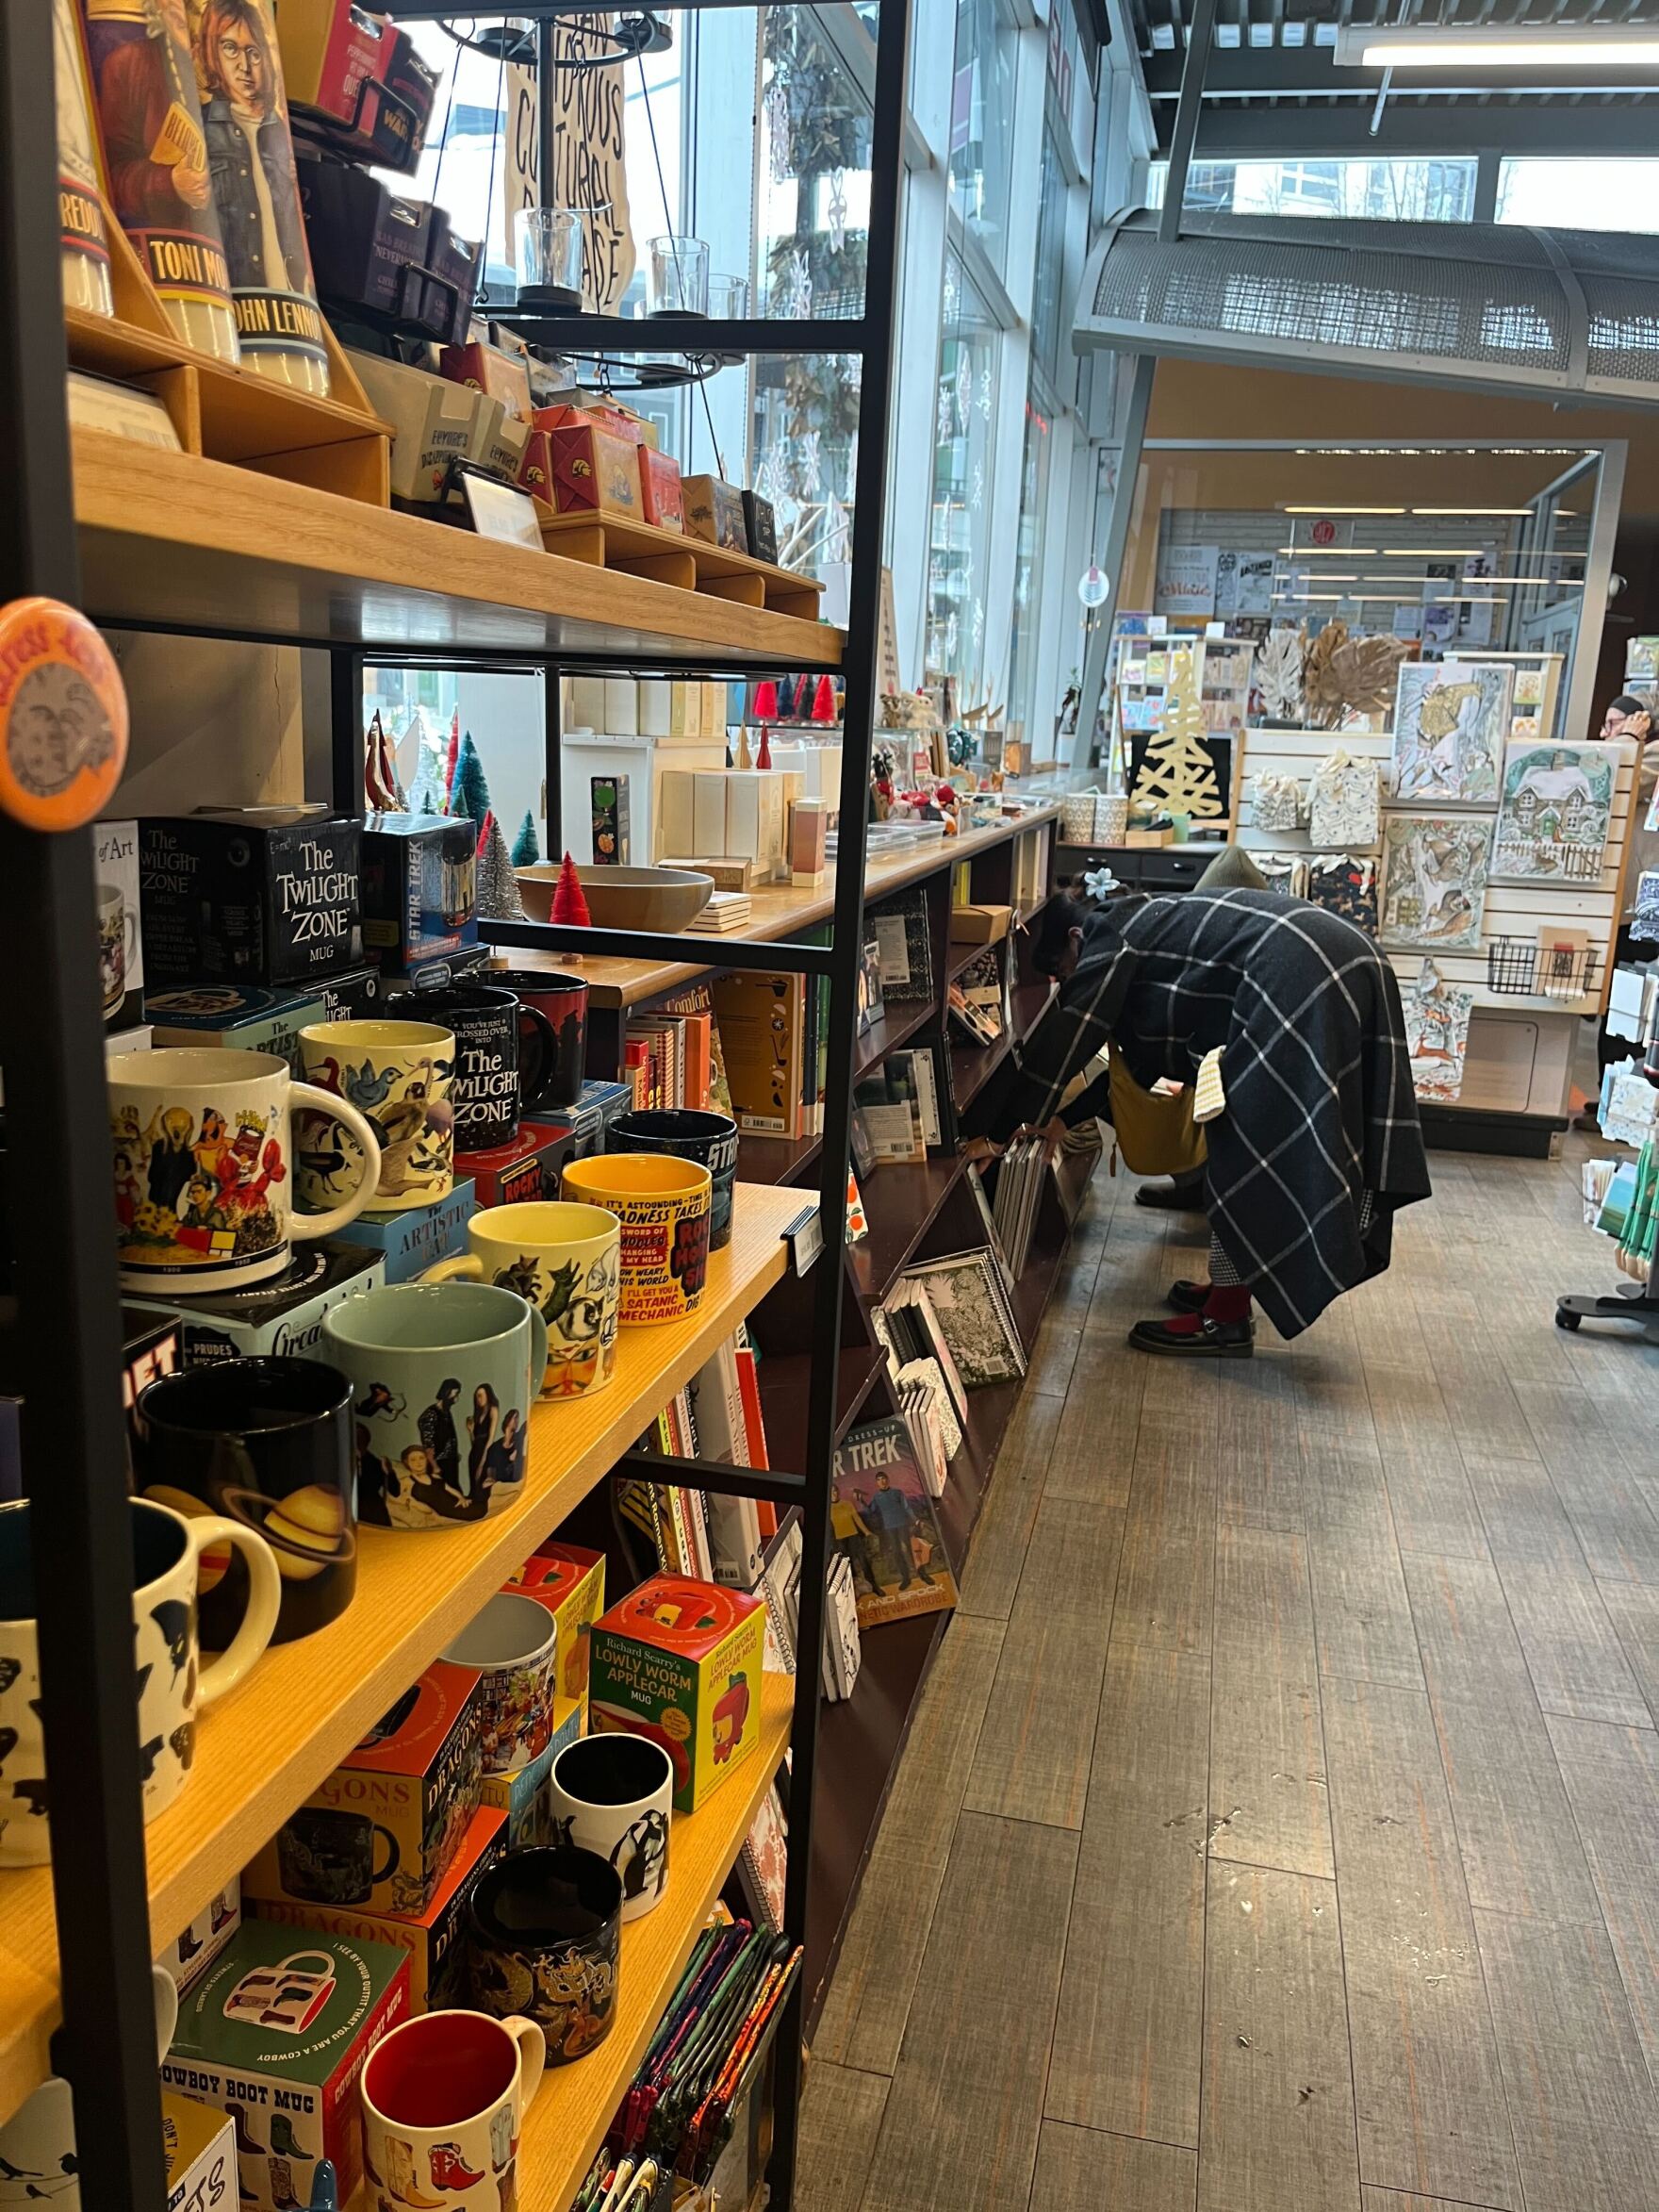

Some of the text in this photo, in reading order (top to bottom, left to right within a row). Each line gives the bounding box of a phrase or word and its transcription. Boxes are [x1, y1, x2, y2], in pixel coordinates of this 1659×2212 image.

[150, 240, 204, 284] TONI
[233, 299, 269, 333] OHN
[109, 837, 133, 861] Art
[149, 830, 177, 850] The
[141, 850, 200, 874] WILIGHT
[299, 840, 334, 871] The
[141, 871, 189, 893] ZONE
[275, 871, 359, 914] TWILIGHT
[408, 840, 423, 941] STAR TREK
[290, 909, 348, 944] ZONE
[309, 945, 334, 963] MUG
[665, 986, 711, 1014] Comfort
[475, 1036, 492, 1045] INTO
[461, 1048, 502, 1073] The
[452, 1071, 518, 1099] WILIGHT
[452, 1099, 512, 1125] ZONE
[504, 1166, 541, 1204] ROCKY
[606, 1199, 623, 1209] IT'S
[674, 1203, 703, 1220] TAKES
[400, 1200, 469, 1255] ARTISTIC
[642, 1255, 664, 1263] HEAD
[618, 1275, 669, 1286] HIS WORLD
[619, 1266, 665, 1277] OW WEARY
[627, 1295, 679, 1310] SATANIC
[643, 1288, 656, 1297] GET
[660, 1286, 673, 1296] YOU
[617, 1304, 685, 1321] MECHANIC
[193, 1343, 233, 1357] PRUDES
[847, 1424, 896, 1444] DRESS-UP
[848, 1434, 902, 1473] TREK
[651, 1502, 665, 1551] Ramen
[859, 1593, 948, 1621] NETIC WARDROBE
[867, 1583, 946, 1610] AND SPOCK
[606, 1637, 682, 1672] Richard Scarry's
[595, 1644, 692, 1692] LOWLY WORM
[607, 1667, 678, 1703] APPLECAR
[631, 1691, 652, 1706] MUG
[322, 1775, 410, 1806] GONS
[377, 1806, 410, 1819] MUG
[267, 1905, 417, 1952] DRAGONS
[337, 1943, 351, 1955] SEE
[349, 1951, 359, 1961] BY
[356, 1959, 370, 1981] YOUR
[360, 1979, 371, 2007] OUTFIT
[346, 2006, 365, 2027] THAT
[332, 2023, 351, 2040] YOU
[256, 2049, 302, 2062] COWBOY
[304, 2047, 311, 2055] A
[311, 2038, 332, 2052] ARE
[334, 1986, 403, 2105] COWBOY BOOT MUG
[226, 2079, 269, 2105] BOOT
[274, 2088, 315, 2114] MUG
[162, 2118, 179, 2148] DON'T
[173, 2189, 185, 2205] TO
